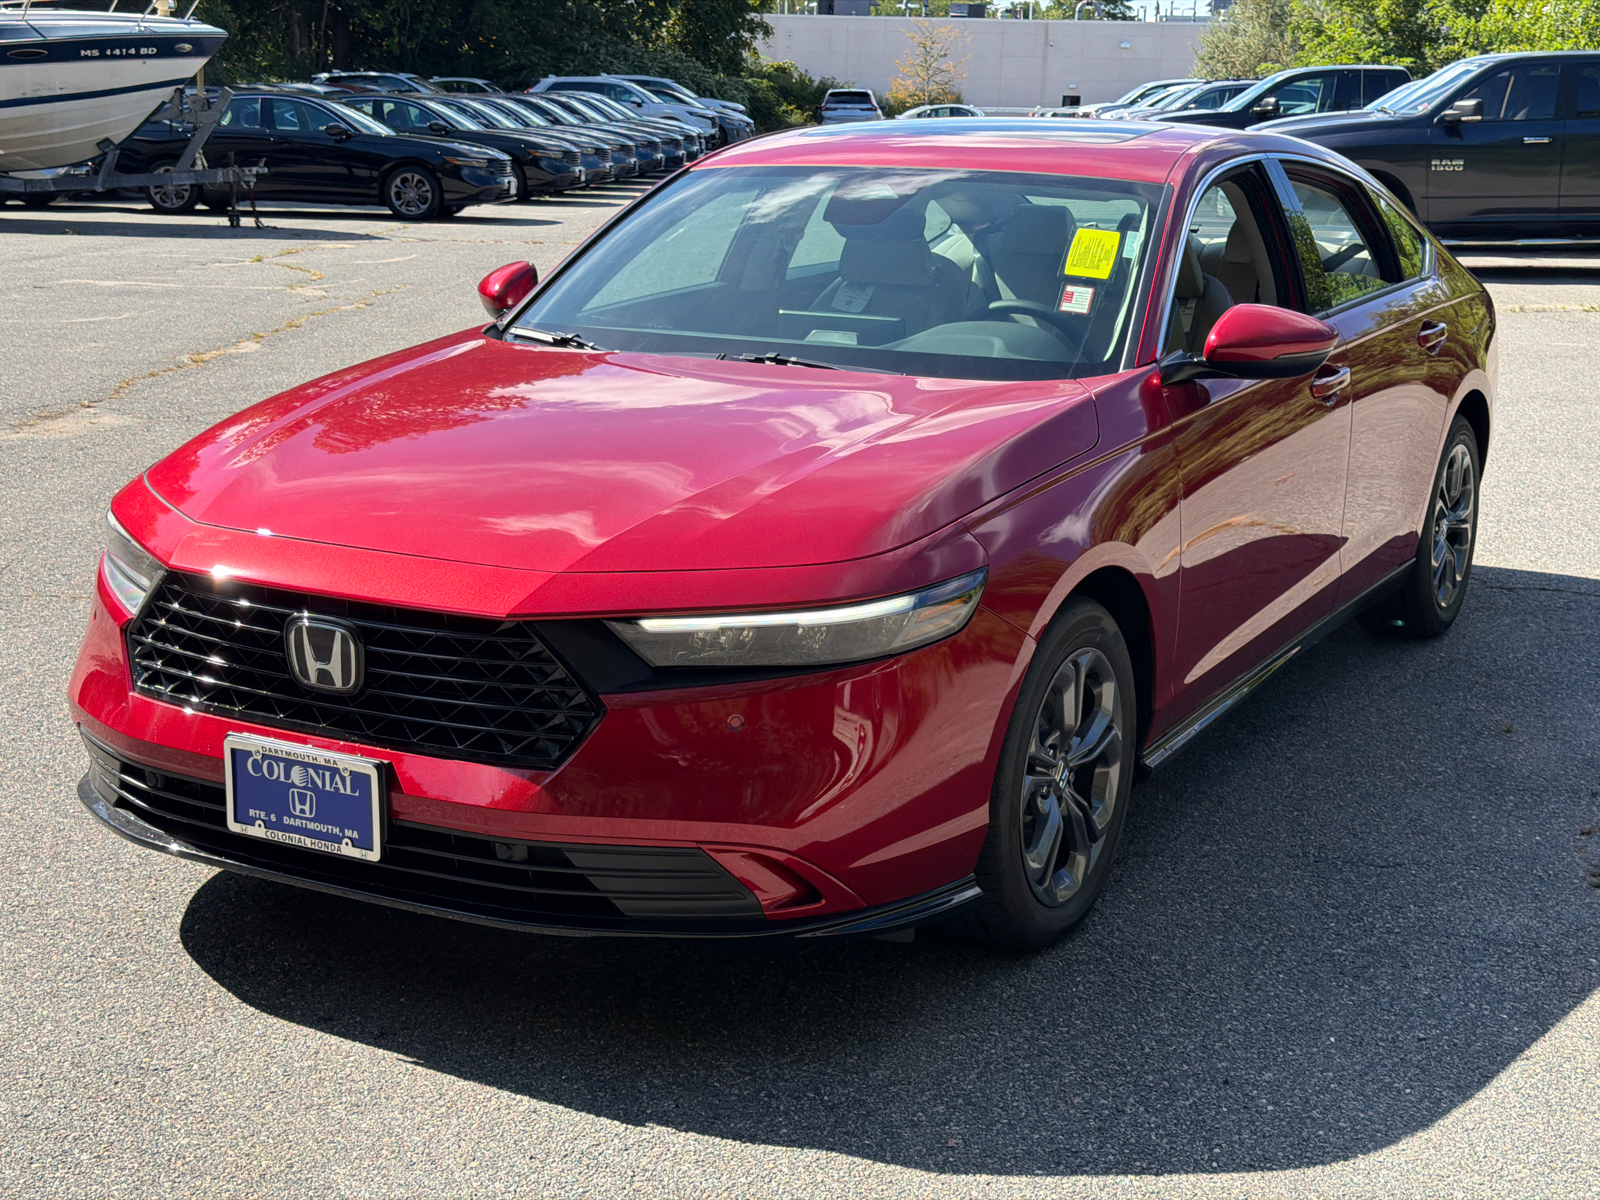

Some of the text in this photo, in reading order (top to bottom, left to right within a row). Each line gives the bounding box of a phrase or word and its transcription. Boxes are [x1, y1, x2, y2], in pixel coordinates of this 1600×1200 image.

[80, 49, 100, 57] MS
[139, 47, 158, 55] BD
[324, 758, 339, 766] MA
[247, 756, 359, 796] COLONIAL
[249, 808, 359, 839] RTE. 6 DARTMOUTH, MA
[264, 830, 342, 853] COLONIAL HONDA
